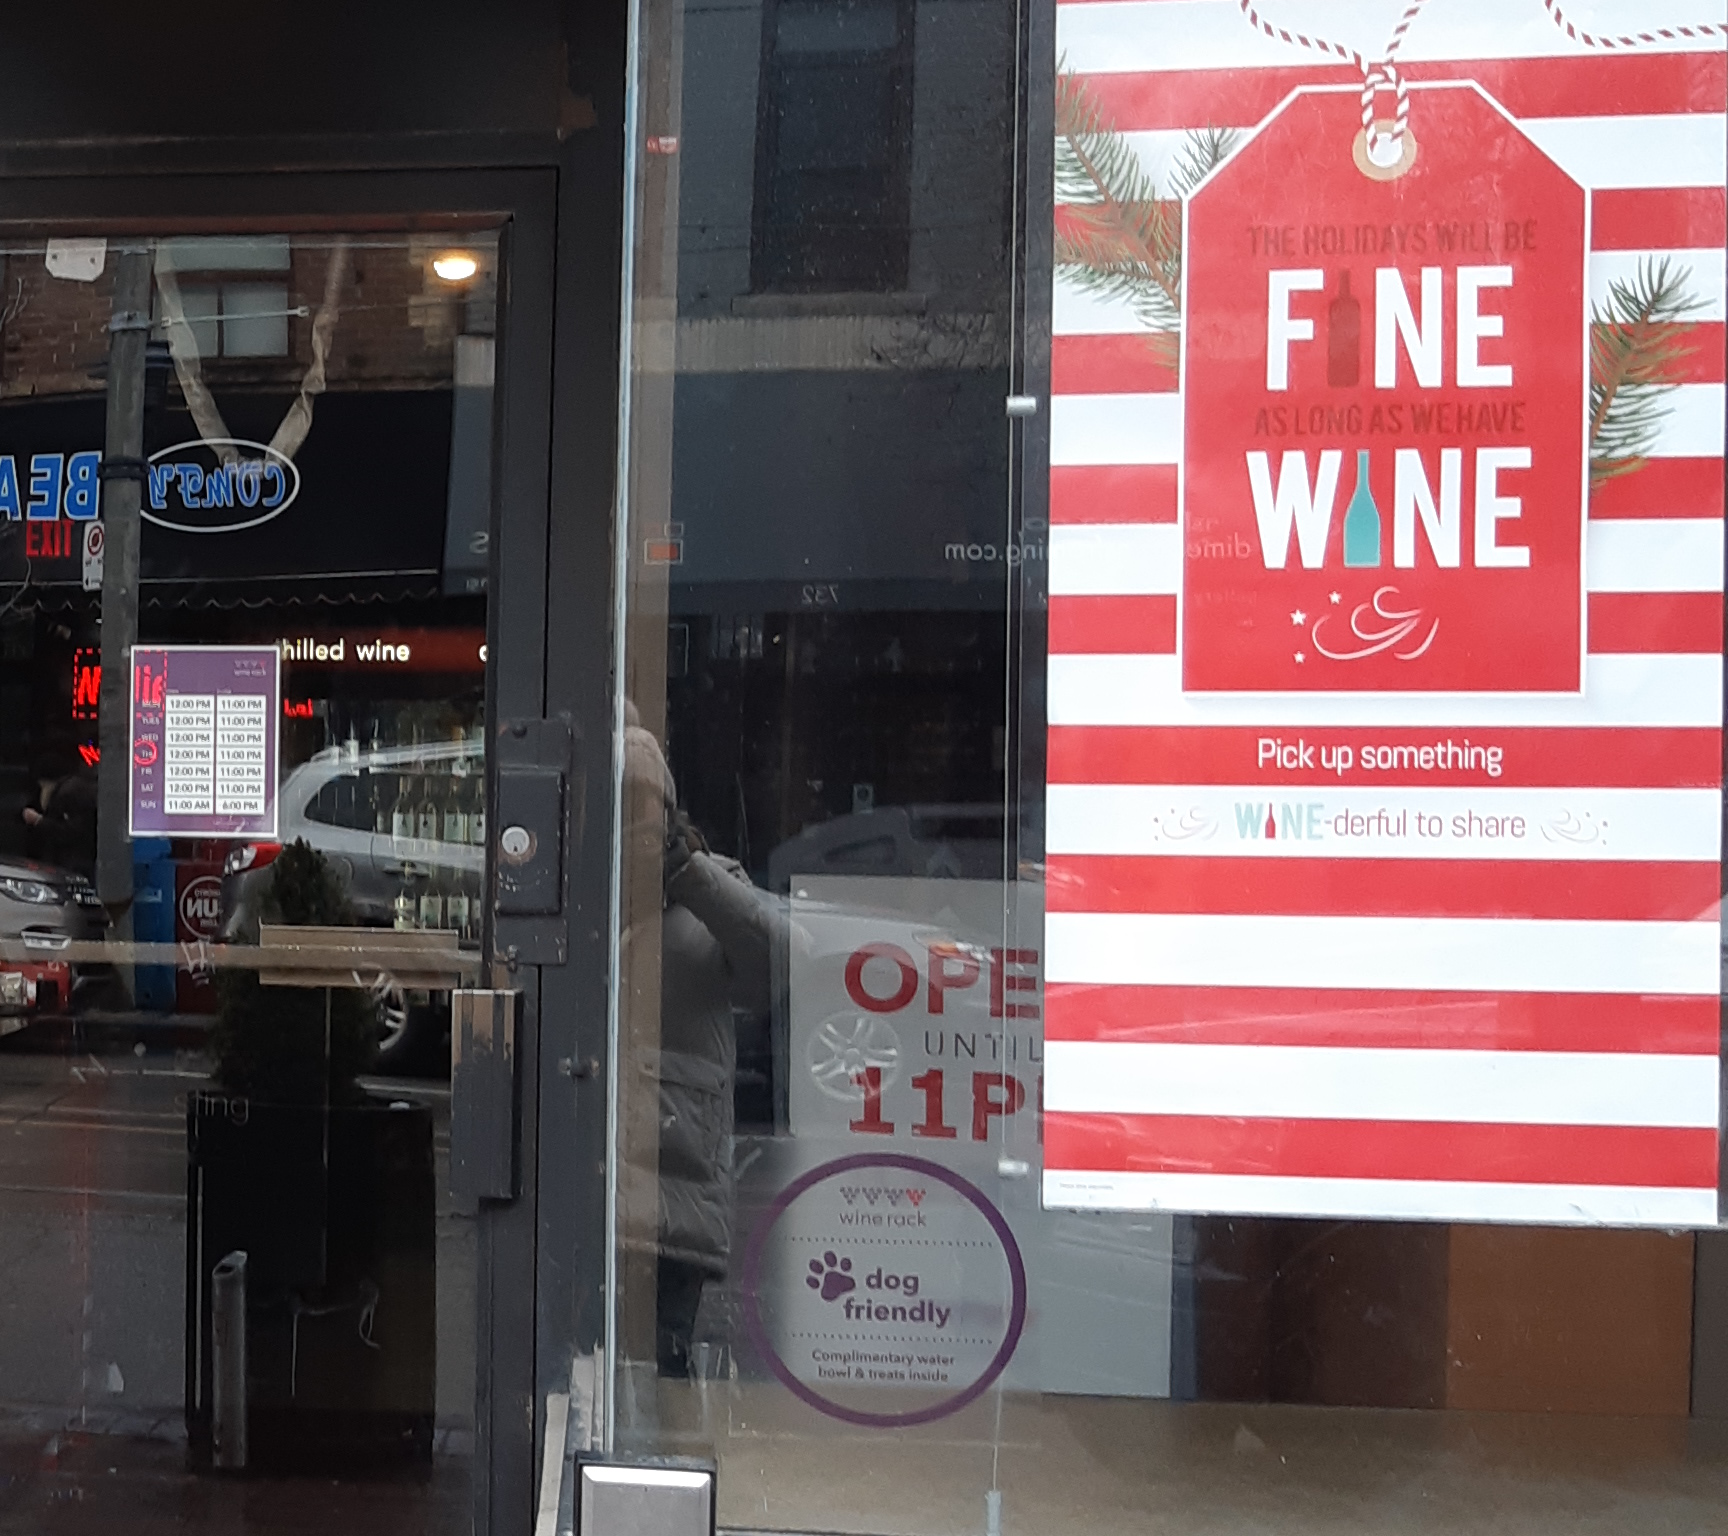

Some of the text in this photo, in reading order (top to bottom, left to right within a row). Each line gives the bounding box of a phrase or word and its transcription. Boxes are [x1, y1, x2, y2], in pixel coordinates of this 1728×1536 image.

[1248, 220, 1537, 256] THE HOLIDAYS WILL BE
[1254, 402, 1526, 436] AS LONG AS WE HAVE
[26, 519, 72, 558] EXIT
[282, 637, 411, 662] hilled wine
[171, 700, 261, 708] 12:00 PM 11:00 PM
[170, 717, 194, 725] 12:00
[196, 717, 210, 725] PM
[221, 717, 245, 725] 11:00
[247, 717, 261, 725] PM
[170, 734, 193, 742] 12:00
[196, 734, 210, 742] PM
[221, 734, 245, 742] 11:00
[247, 734, 261, 742] PM
[170, 750, 193, 759] 12:00
[196, 750, 209, 759] PM
[221, 750, 244, 759] 11:00
[247, 750, 261, 759] PM
[1257, 737, 1504, 777] Pick up something
[170, 767, 193, 776] 12:00
[196, 767, 209, 776] PM
[221, 767, 244, 776] 11:00
[247, 767, 261, 776] PM
[170, 784, 193, 793] 12:00
[195, 784, 209, 793] PM
[221, 784, 244, 793] 11:00
[247, 784, 260, 793] PM
[168, 801, 192, 809] 11:00
[194, 801, 210, 809] AM
[223, 801, 241, 809] 6:00
[244, 801, 258, 809] PM
[1416, 811, 1443, 839] to
[1451, 809, 1527, 840] share
[844, 942, 1040, 1020] OPE
[923, 1030, 1042, 1062] UNTIL
[848, 1065, 1043, 1143] 11P
[839, 1210, 927, 1228] wine rack
[865, 1267, 920, 1297] dog
[843, 1296, 951, 1329] friendly
[811, 1348, 955, 1366] Complimentary water
[818, 1365, 949, 1383] bowl & treats inside
